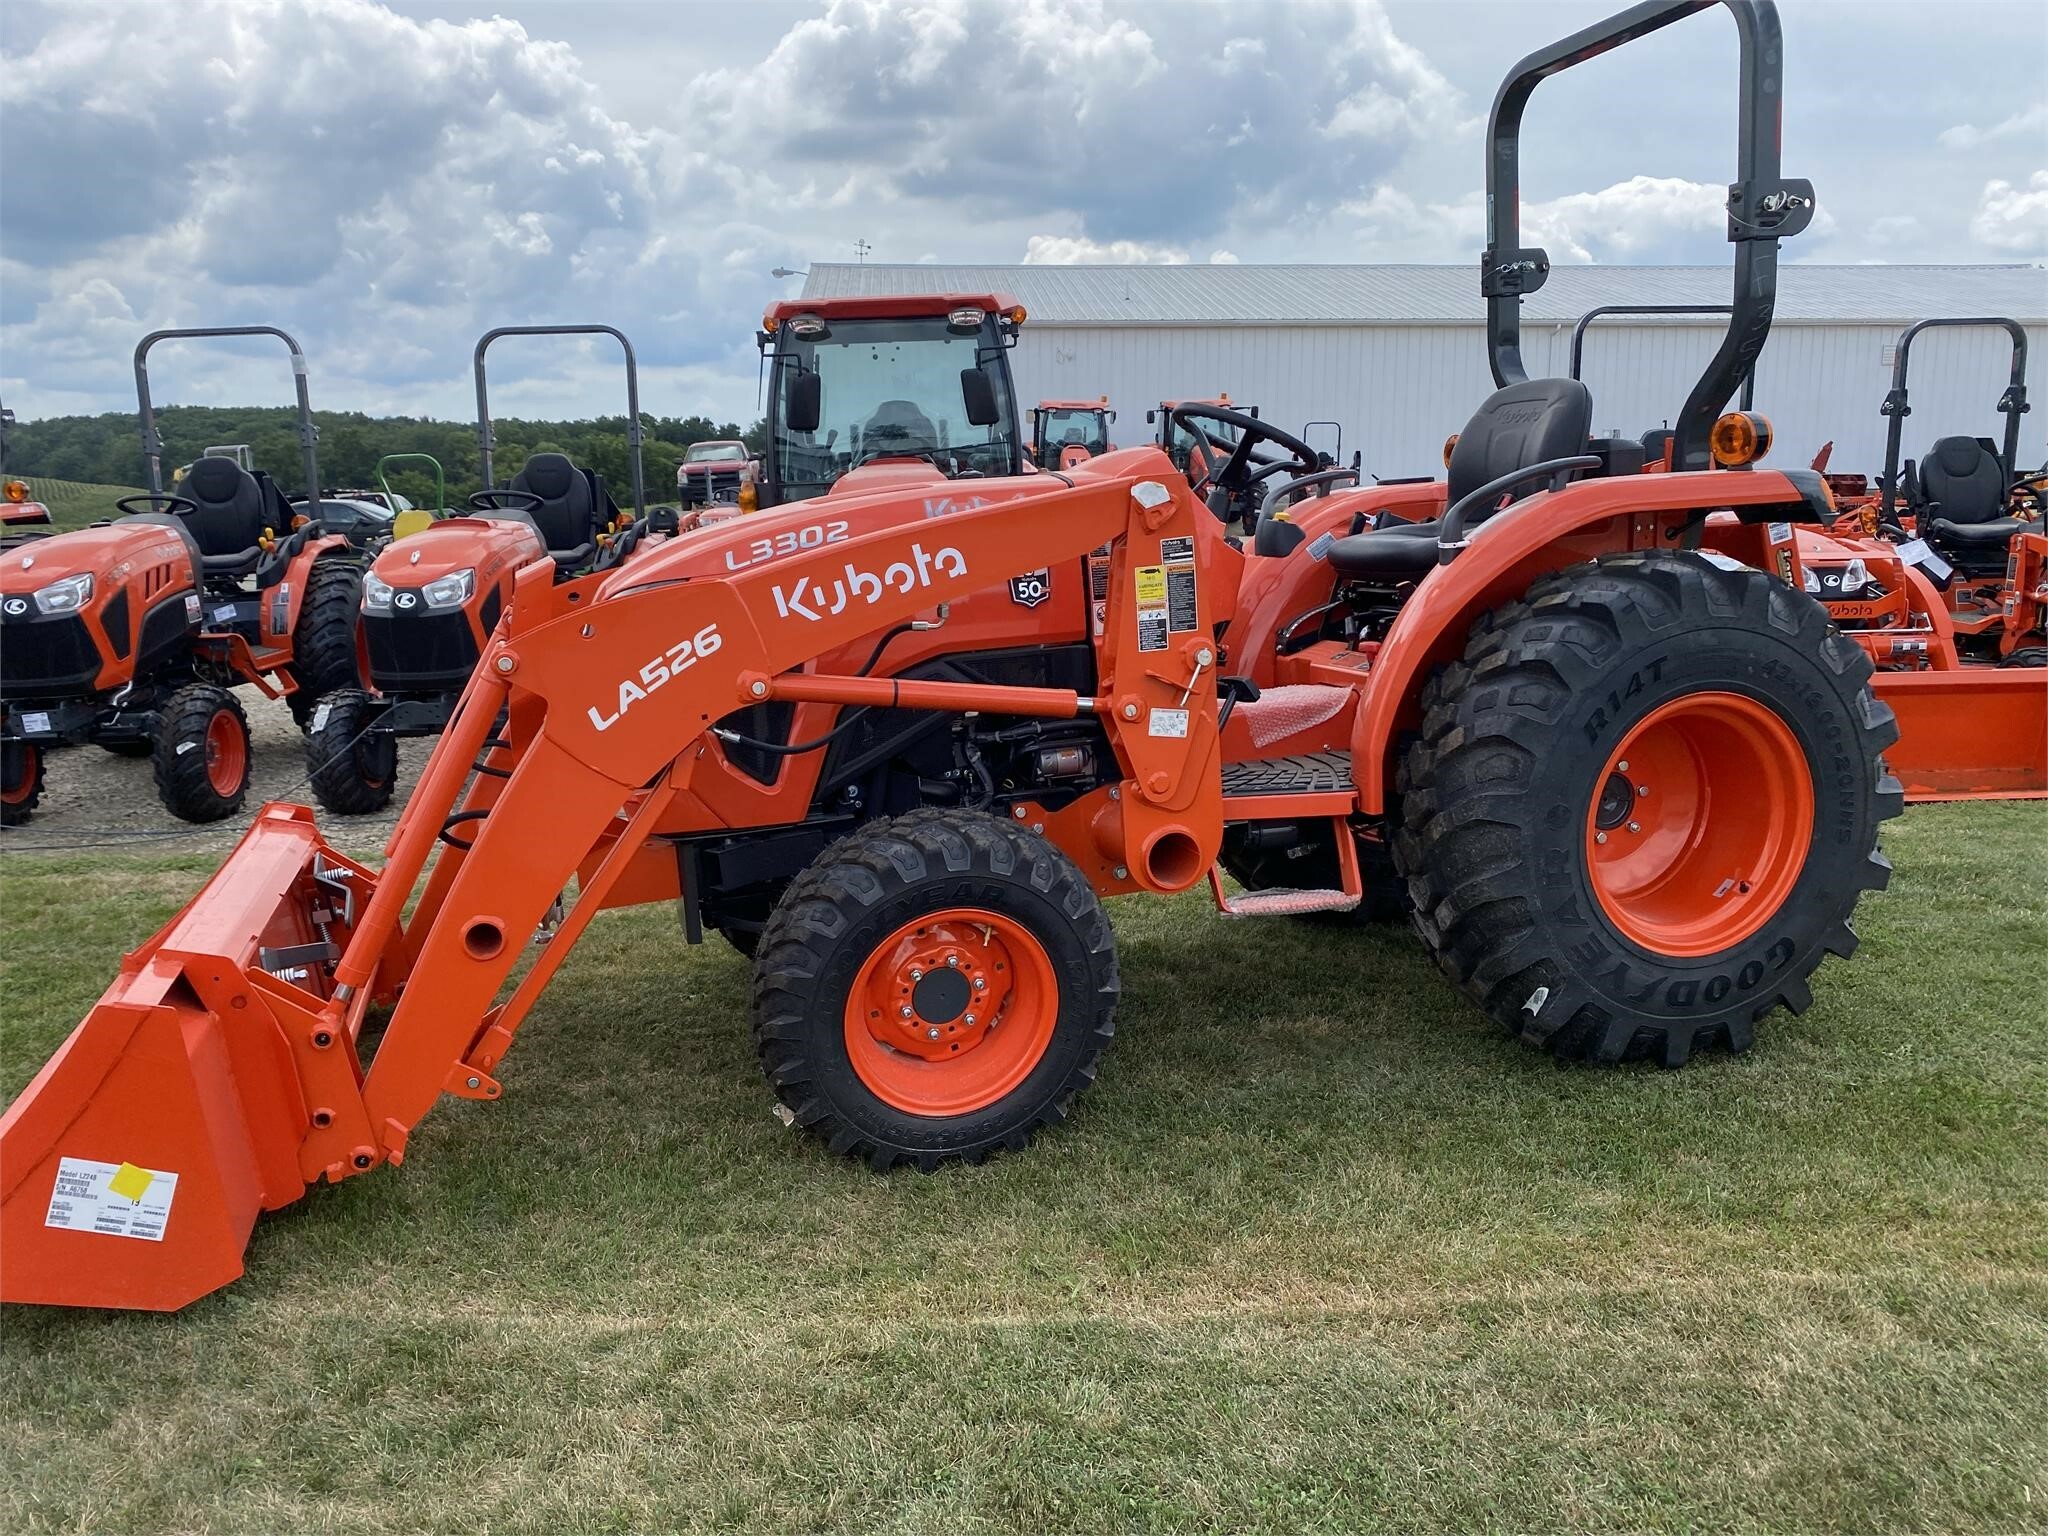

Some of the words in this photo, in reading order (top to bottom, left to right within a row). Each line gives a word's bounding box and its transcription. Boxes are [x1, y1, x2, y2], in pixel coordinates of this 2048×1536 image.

[726, 520, 849, 571] L3302
[771, 543, 968, 622] Kubota
[1018, 581, 1042, 599] 50
[587, 623, 723, 732] LA526
[1583, 655, 1669, 747] R14T
[60, 1169, 78, 1178] Model
